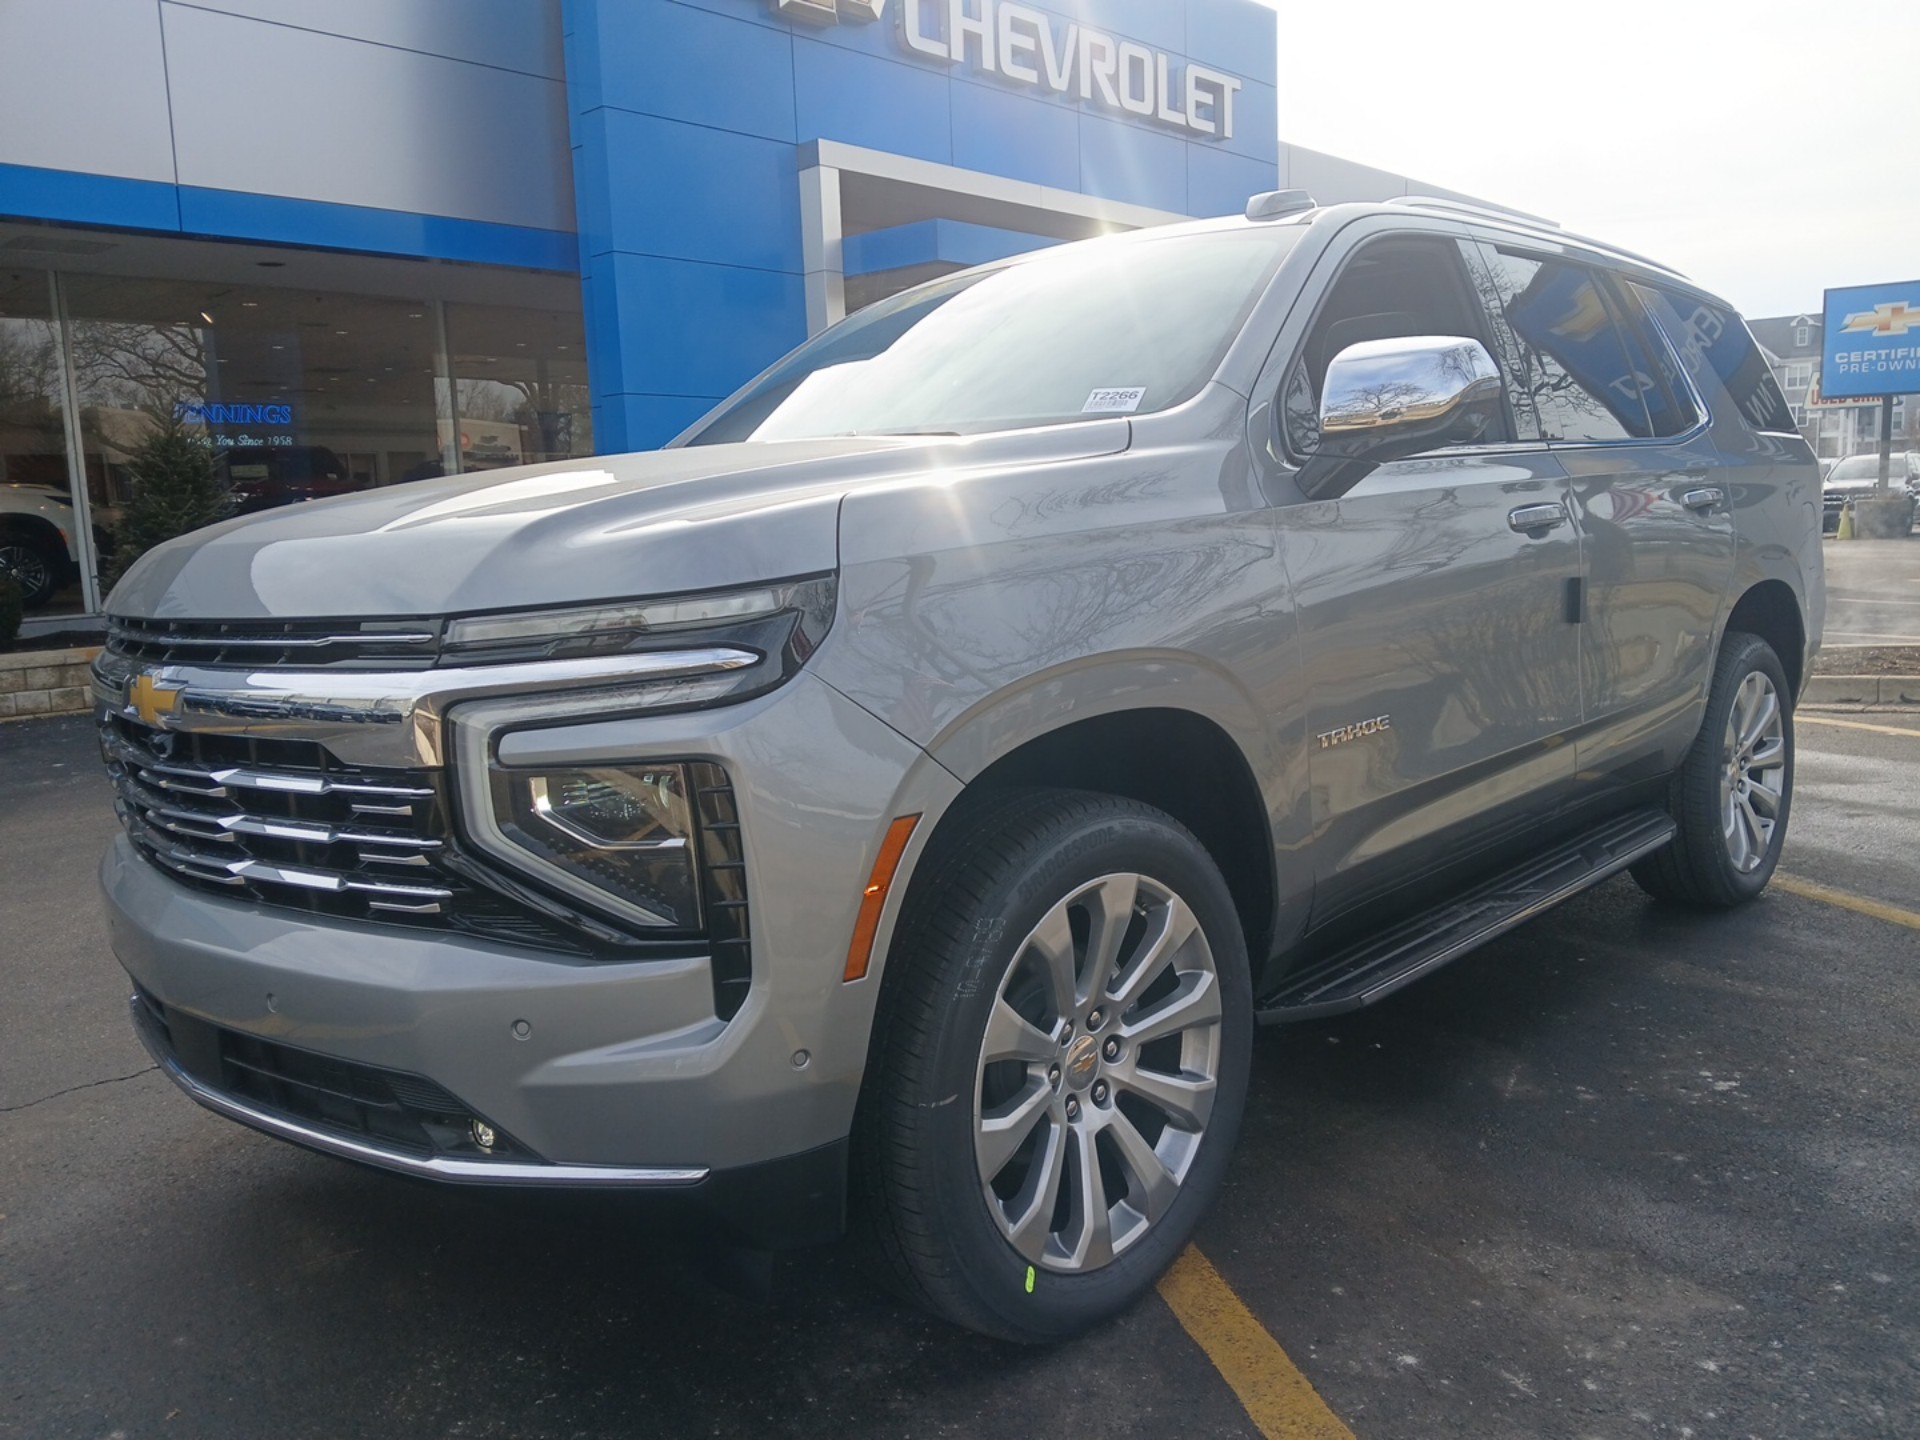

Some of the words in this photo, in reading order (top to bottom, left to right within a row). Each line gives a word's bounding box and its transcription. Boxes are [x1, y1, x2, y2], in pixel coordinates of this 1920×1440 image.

[903, 0, 1241, 139] CHEVROLET
[1840, 360, 1920, 374] PRE-OWN
[216, 435, 234, 446] You
[238, 435, 263, 446] Since
[267, 436, 292, 446] 1958
[1317, 714, 1390, 749] TAHOE
